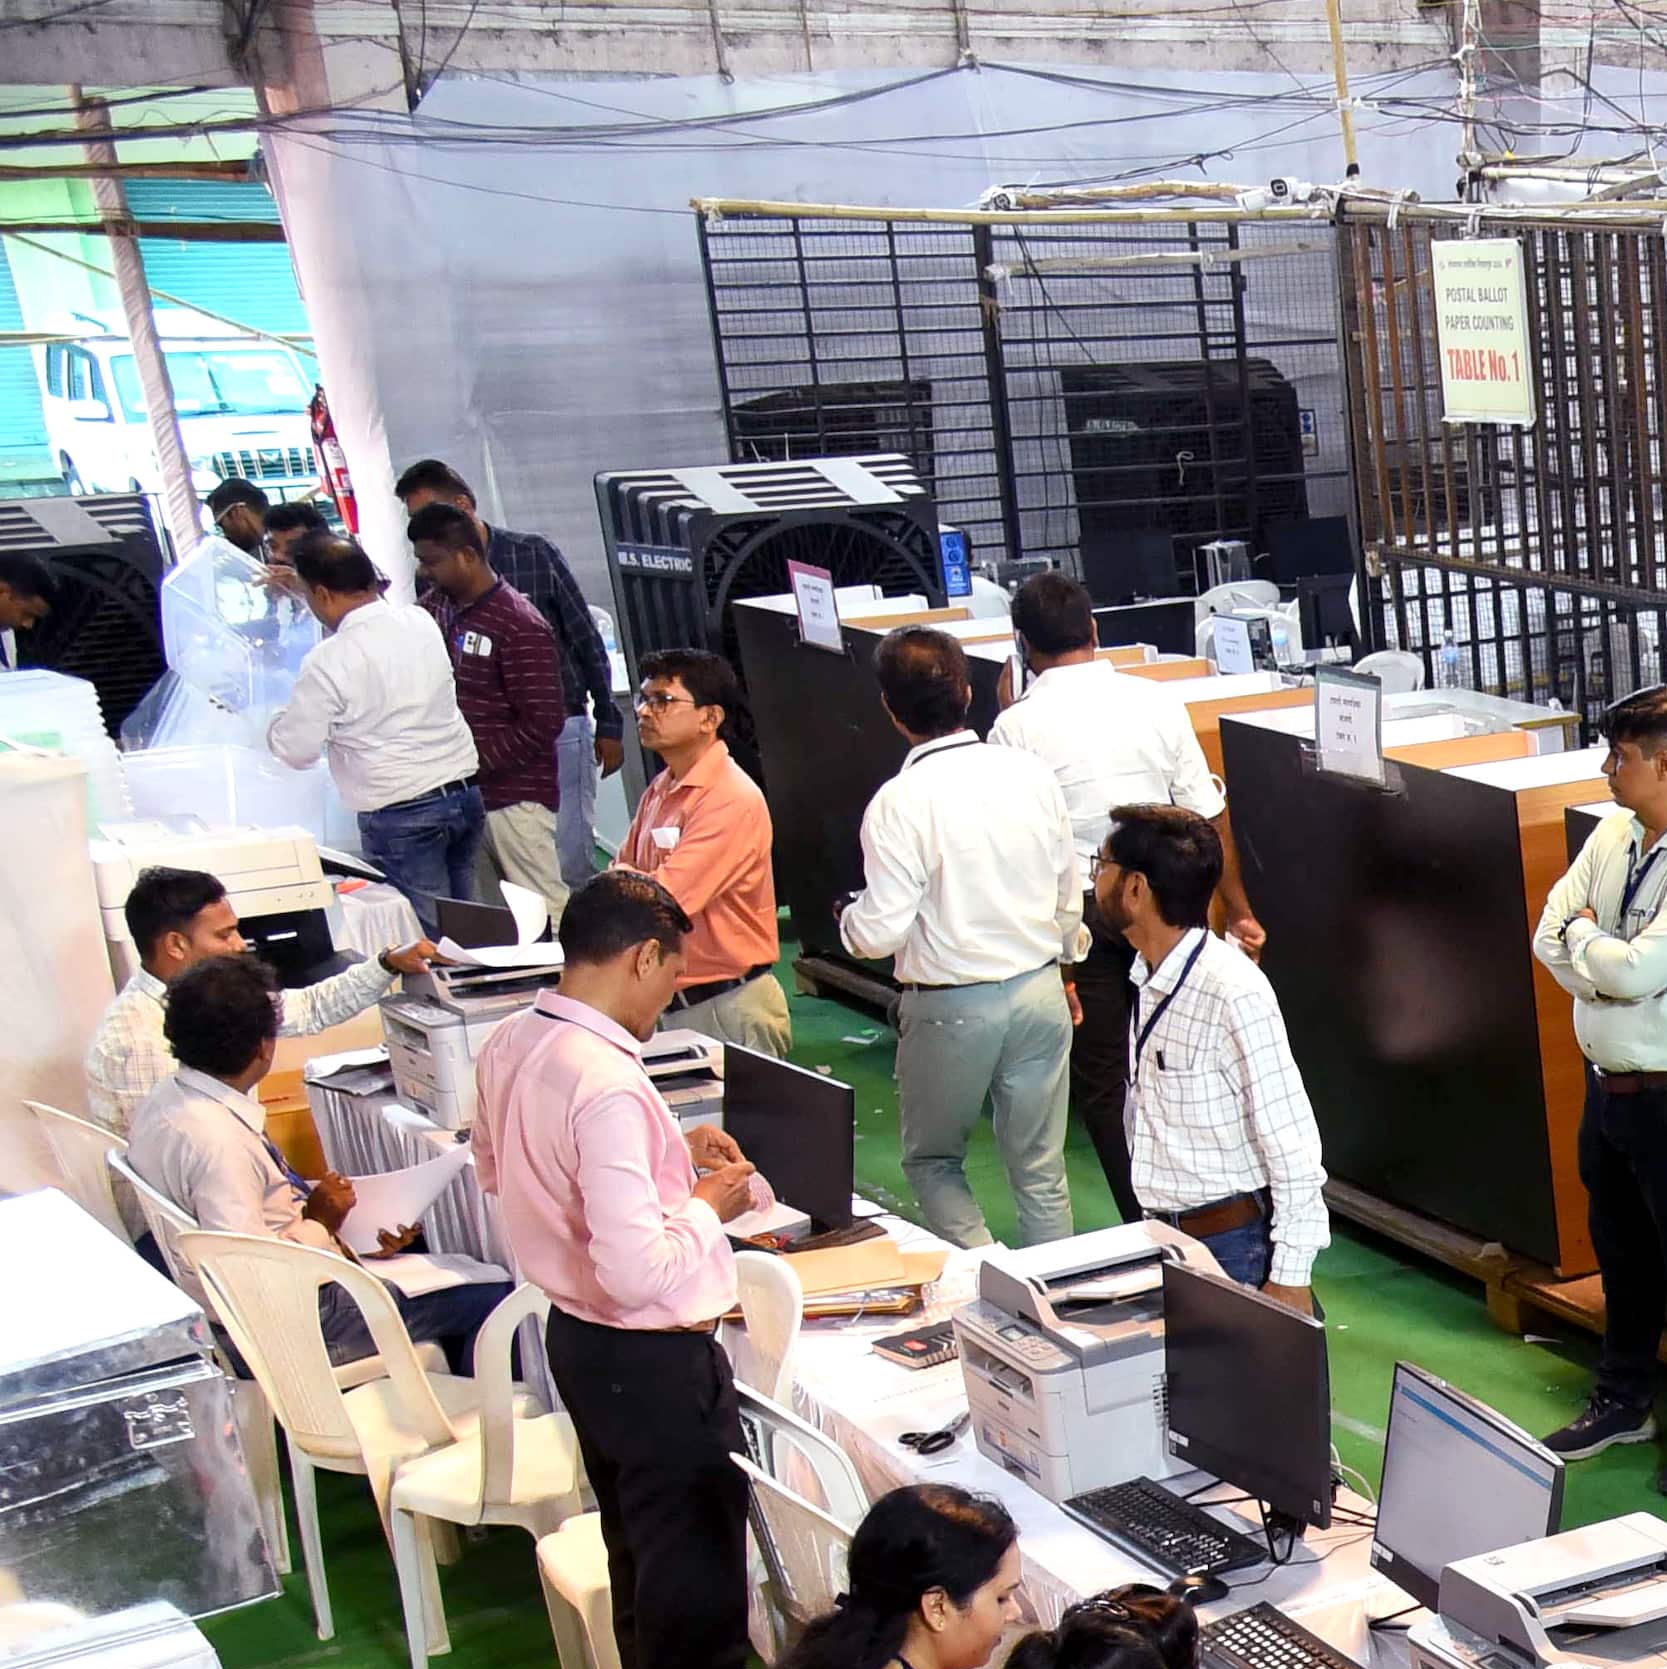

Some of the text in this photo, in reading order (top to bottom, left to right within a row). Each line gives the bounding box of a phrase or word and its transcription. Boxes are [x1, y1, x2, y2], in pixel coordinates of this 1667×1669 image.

[1446, 287, 1508, 302] POSTAL BALLOT
[1445, 315, 1514, 331] PAPER COUNTING
[1447, 349, 1520, 382] TABLE No. 1
[641, 553, 693, 572] ELECTRIC
